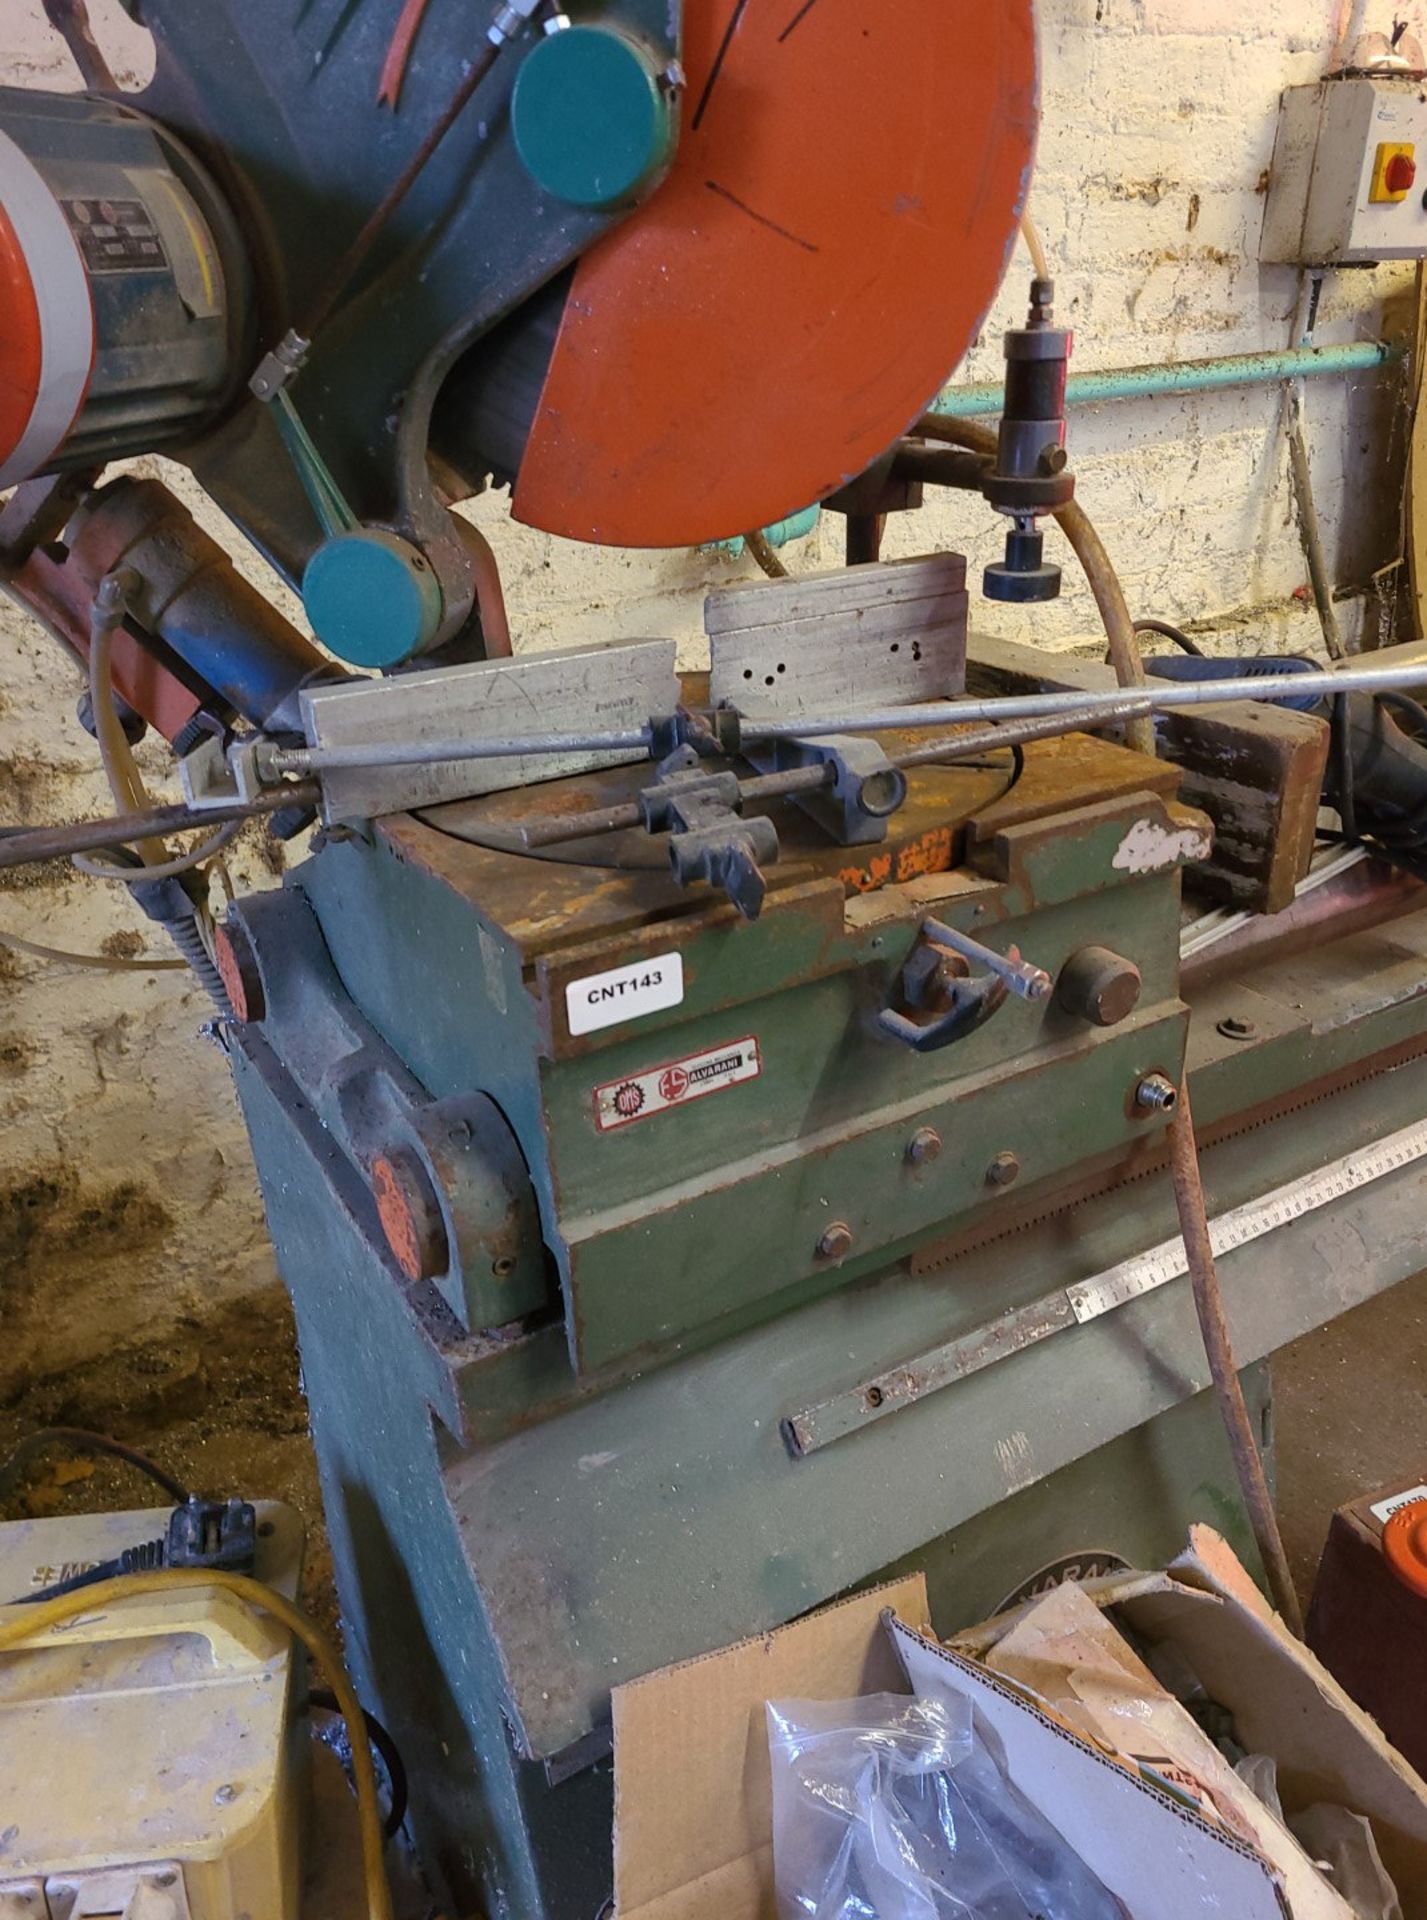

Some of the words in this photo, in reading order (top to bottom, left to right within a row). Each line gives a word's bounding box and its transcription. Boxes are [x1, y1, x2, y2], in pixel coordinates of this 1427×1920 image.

[587, 971, 663, 1005] CNT143
[690, 1058, 738, 1082] ALVARANI
[618, 1087, 640, 1112] OMS
